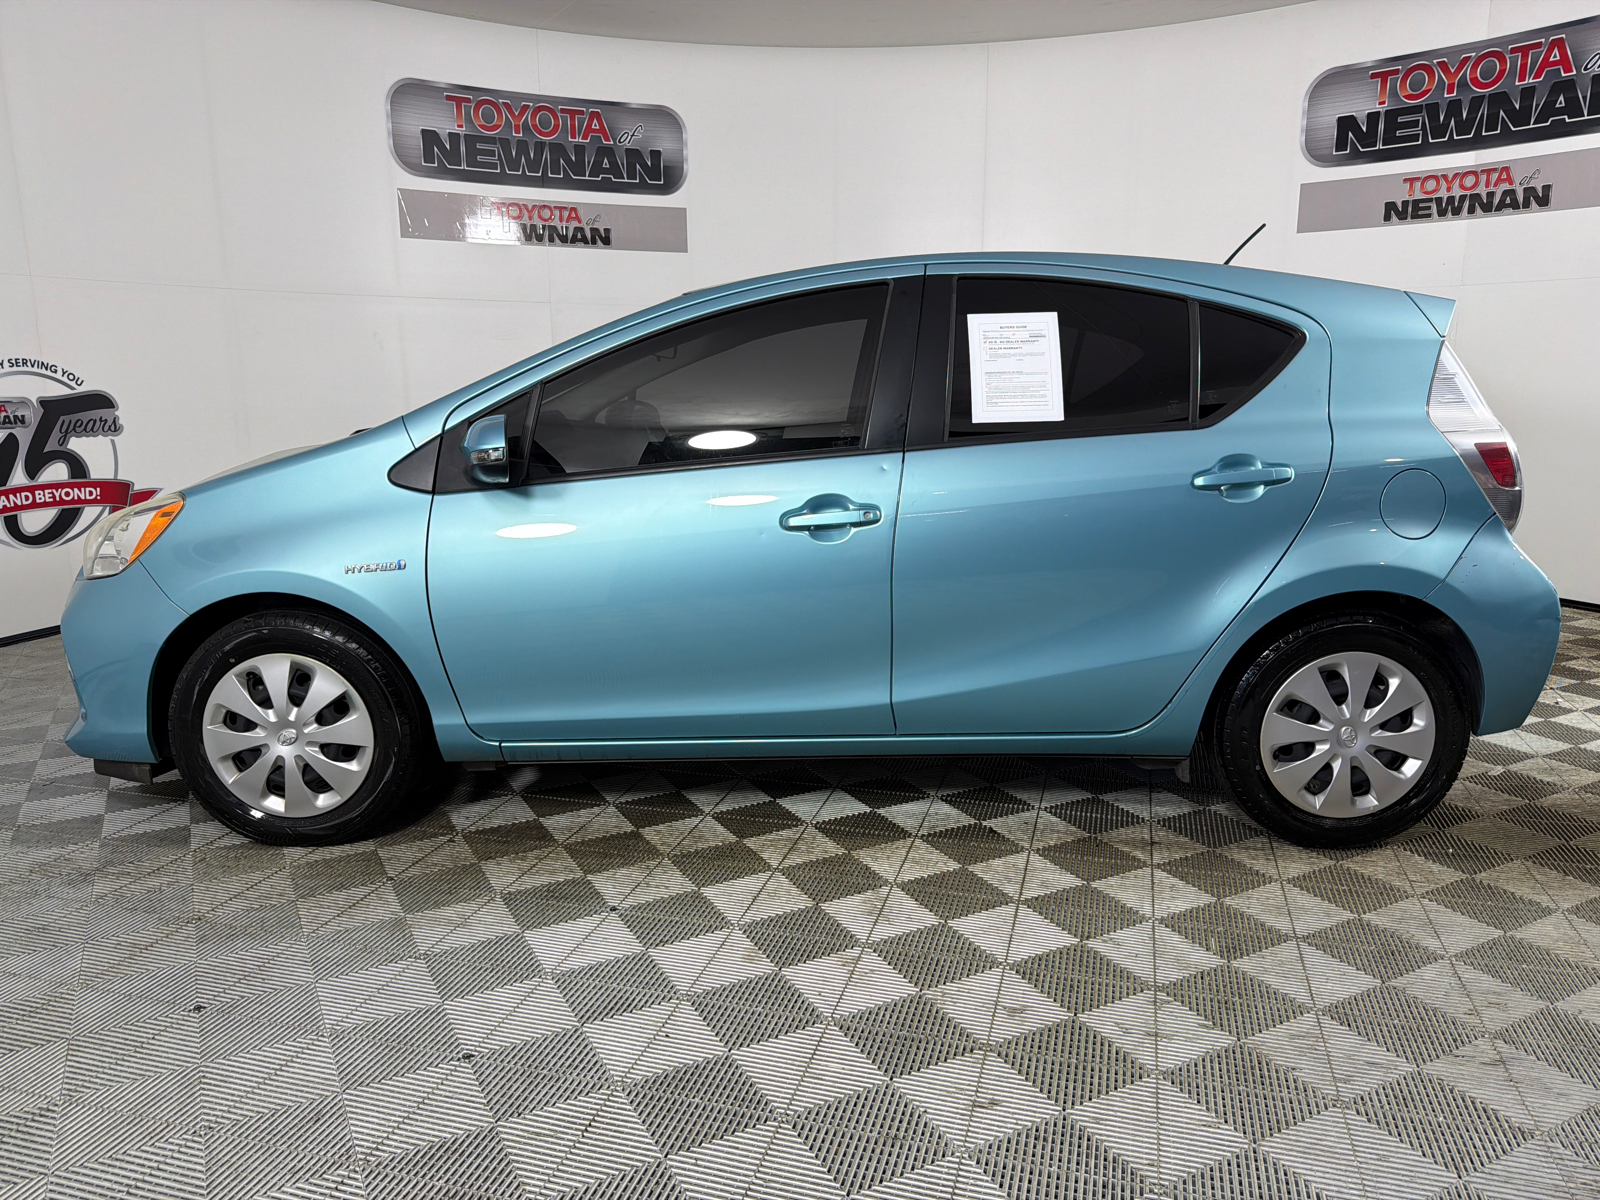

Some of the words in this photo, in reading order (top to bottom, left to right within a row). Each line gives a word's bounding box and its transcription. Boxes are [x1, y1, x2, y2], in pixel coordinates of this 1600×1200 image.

[1369, 34, 1576, 107] TOYOTA
[1582, 51, 1600, 73] o
[444, 92, 613, 144] TOYOTA
[617, 124, 643, 146] of
[420, 127, 664, 184] NEWNAN
[1403, 165, 1515, 198] TOYOTA
[1519, 168, 1541, 186] of
[491, 201, 583, 225] TOYOTA
[1382, 183, 1552, 224] NEWNAN
[518, 222, 613, 248] WNAN
[8, 358, 58, 374] SERVING
[61, 367, 84, 387] YOU
[58, 415, 121, 447] years
[0, 492, 32, 509] AND
[35, 487, 101, 504] BEYOND!
